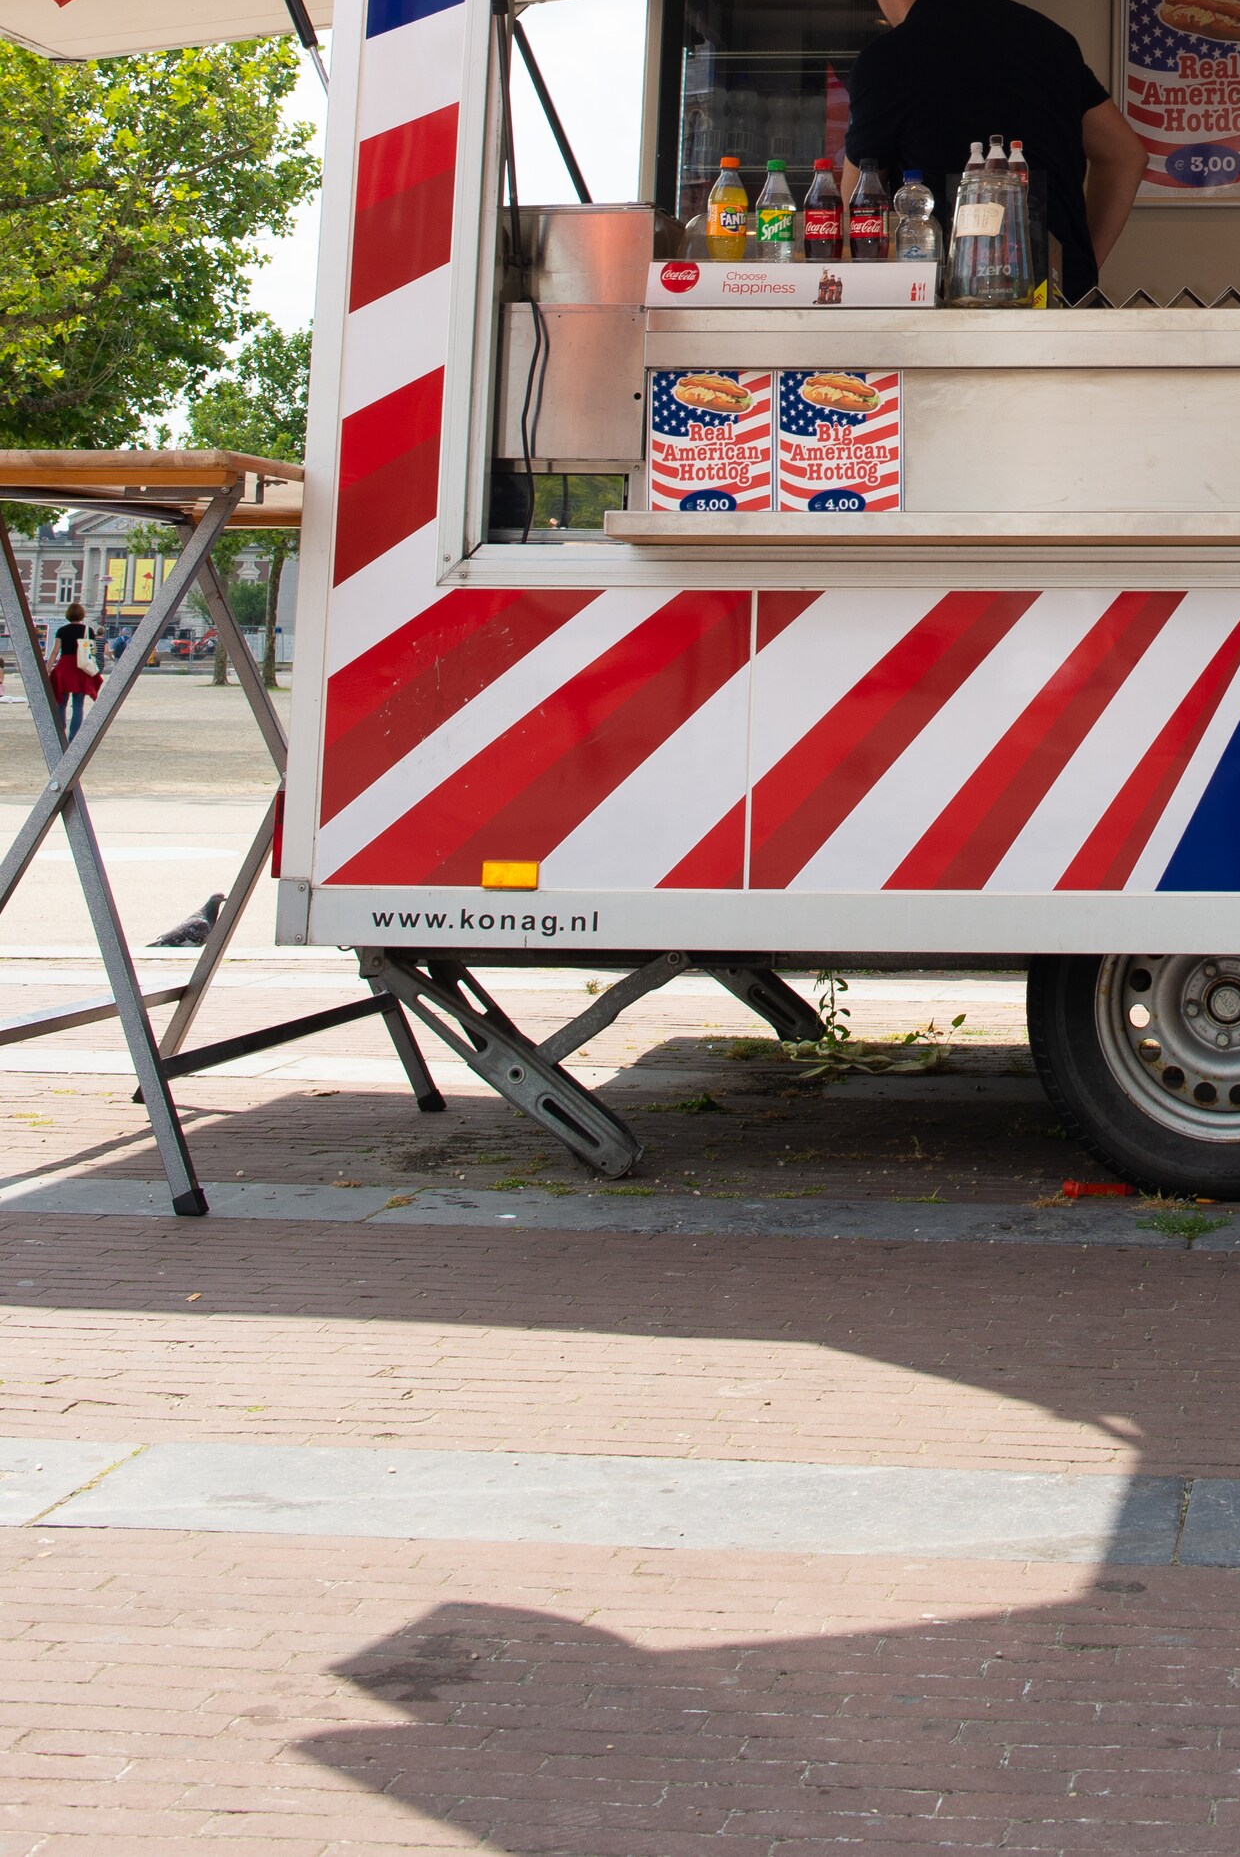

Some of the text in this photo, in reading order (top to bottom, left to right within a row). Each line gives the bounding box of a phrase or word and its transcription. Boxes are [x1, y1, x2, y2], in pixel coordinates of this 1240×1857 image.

[1178, 54, 1240, 80] Real
[1190, 156, 1236, 174] 3,00
[719, 212, 746, 226] FANT
[761, 215, 793, 241] Sprite
[726, 271, 767, 282] Choose
[977, 264, 1011, 277] zero
[722, 280, 796, 296] happiness
[689, 423, 734, 442] Real
[817, 423, 853, 445] Big
[663, 443, 761, 461] American
[790, 443, 889, 461] American
[678, 463, 750, 485] Hotdog
[807, 463, 879, 484] Hotdog
[696, 498, 729, 511] 3,00
[825, 498, 859, 511] 4,00
[371, 908, 600, 936] www.konag.nl
